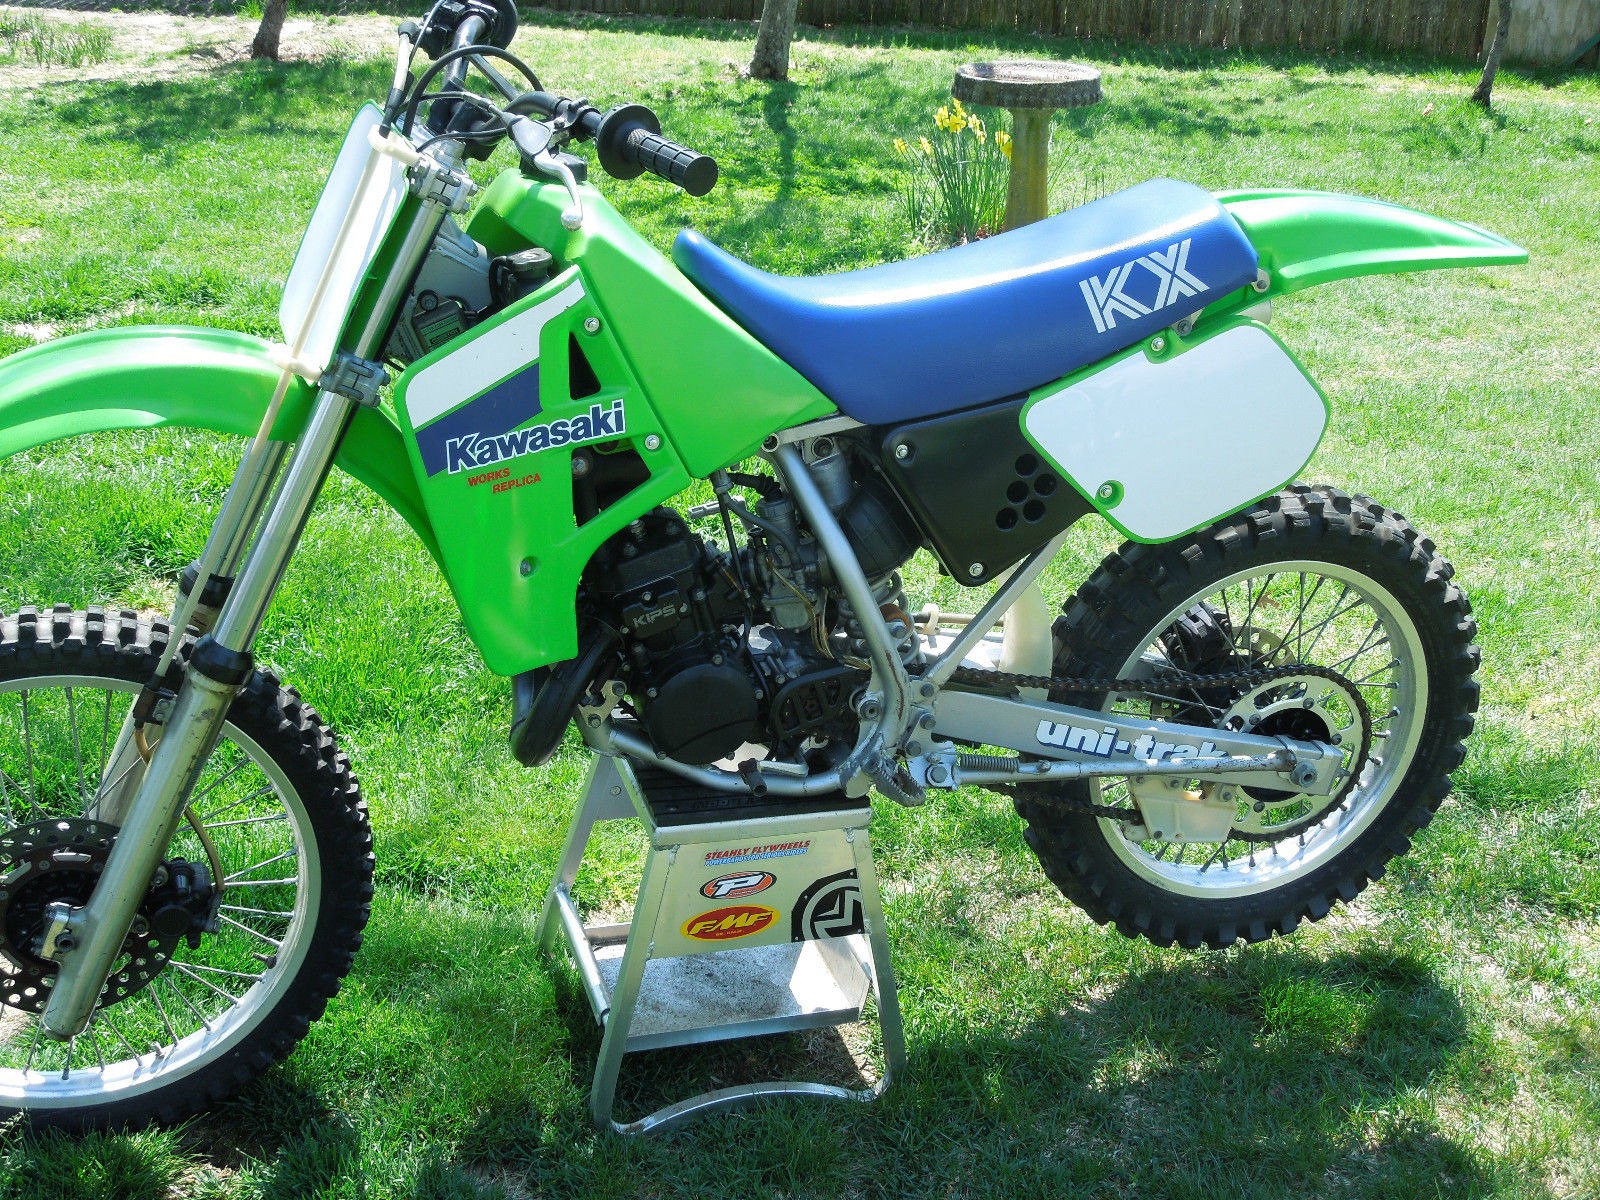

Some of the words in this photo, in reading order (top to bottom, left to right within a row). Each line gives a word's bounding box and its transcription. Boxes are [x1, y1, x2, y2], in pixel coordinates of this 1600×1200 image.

[1079, 238, 1210, 333] KX
[446, 399, 626, 475] Kawasaki
[467, 468, 510, 487] WORKS
[492, 473, 541, 494] REPLICA
[633, 604, 676, 629] KIPS
[704, 847, 751, 860] STEAHLY
[751, 840, 811, 854] FLYWHEELS
[687, 911, 774, 935] FMF
